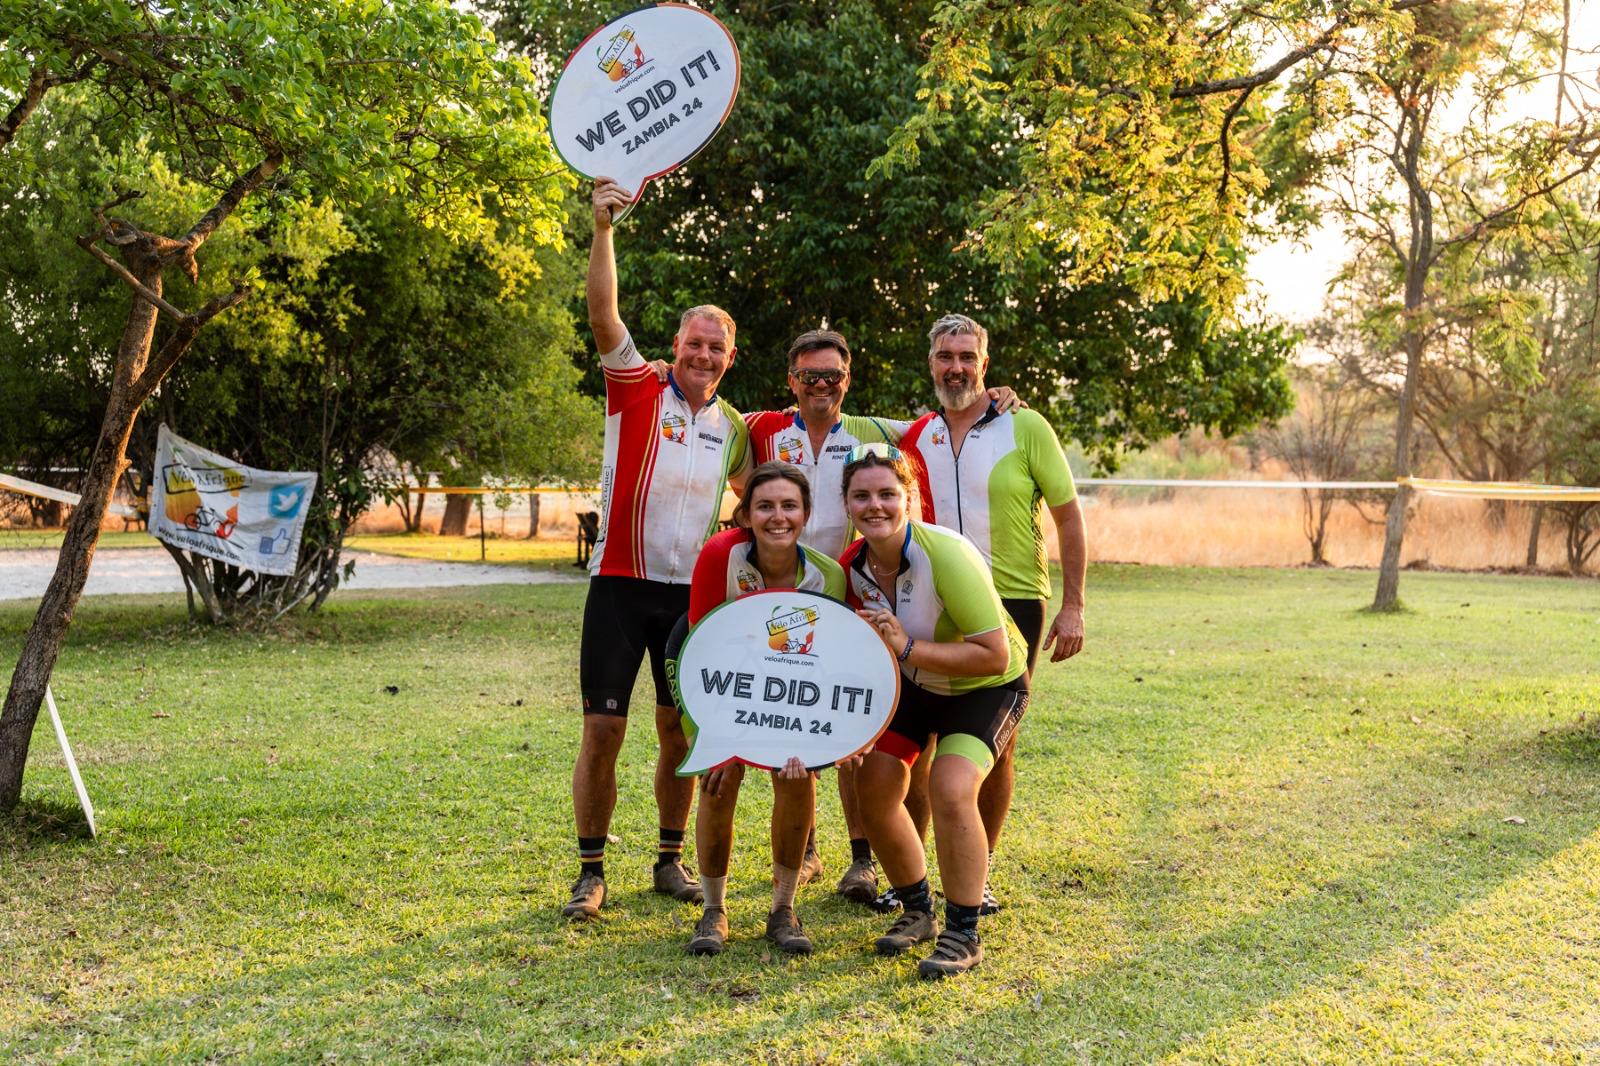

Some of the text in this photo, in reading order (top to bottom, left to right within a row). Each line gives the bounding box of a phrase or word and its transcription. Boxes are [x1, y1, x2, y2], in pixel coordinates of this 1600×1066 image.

[615, 66, 655, 93] veloafrique.com
[576, 50, 721, 152] WE DID IT!
[622, 97, 703, 155] ZAMBIA 24
[790, 611, 816, 625] Afrique
[764, 656, 814, 666] veloafrique.com
[701, 668, 873, 715] WE DID IT!
[734, 709, 832, 735] ZAMBIA 24
